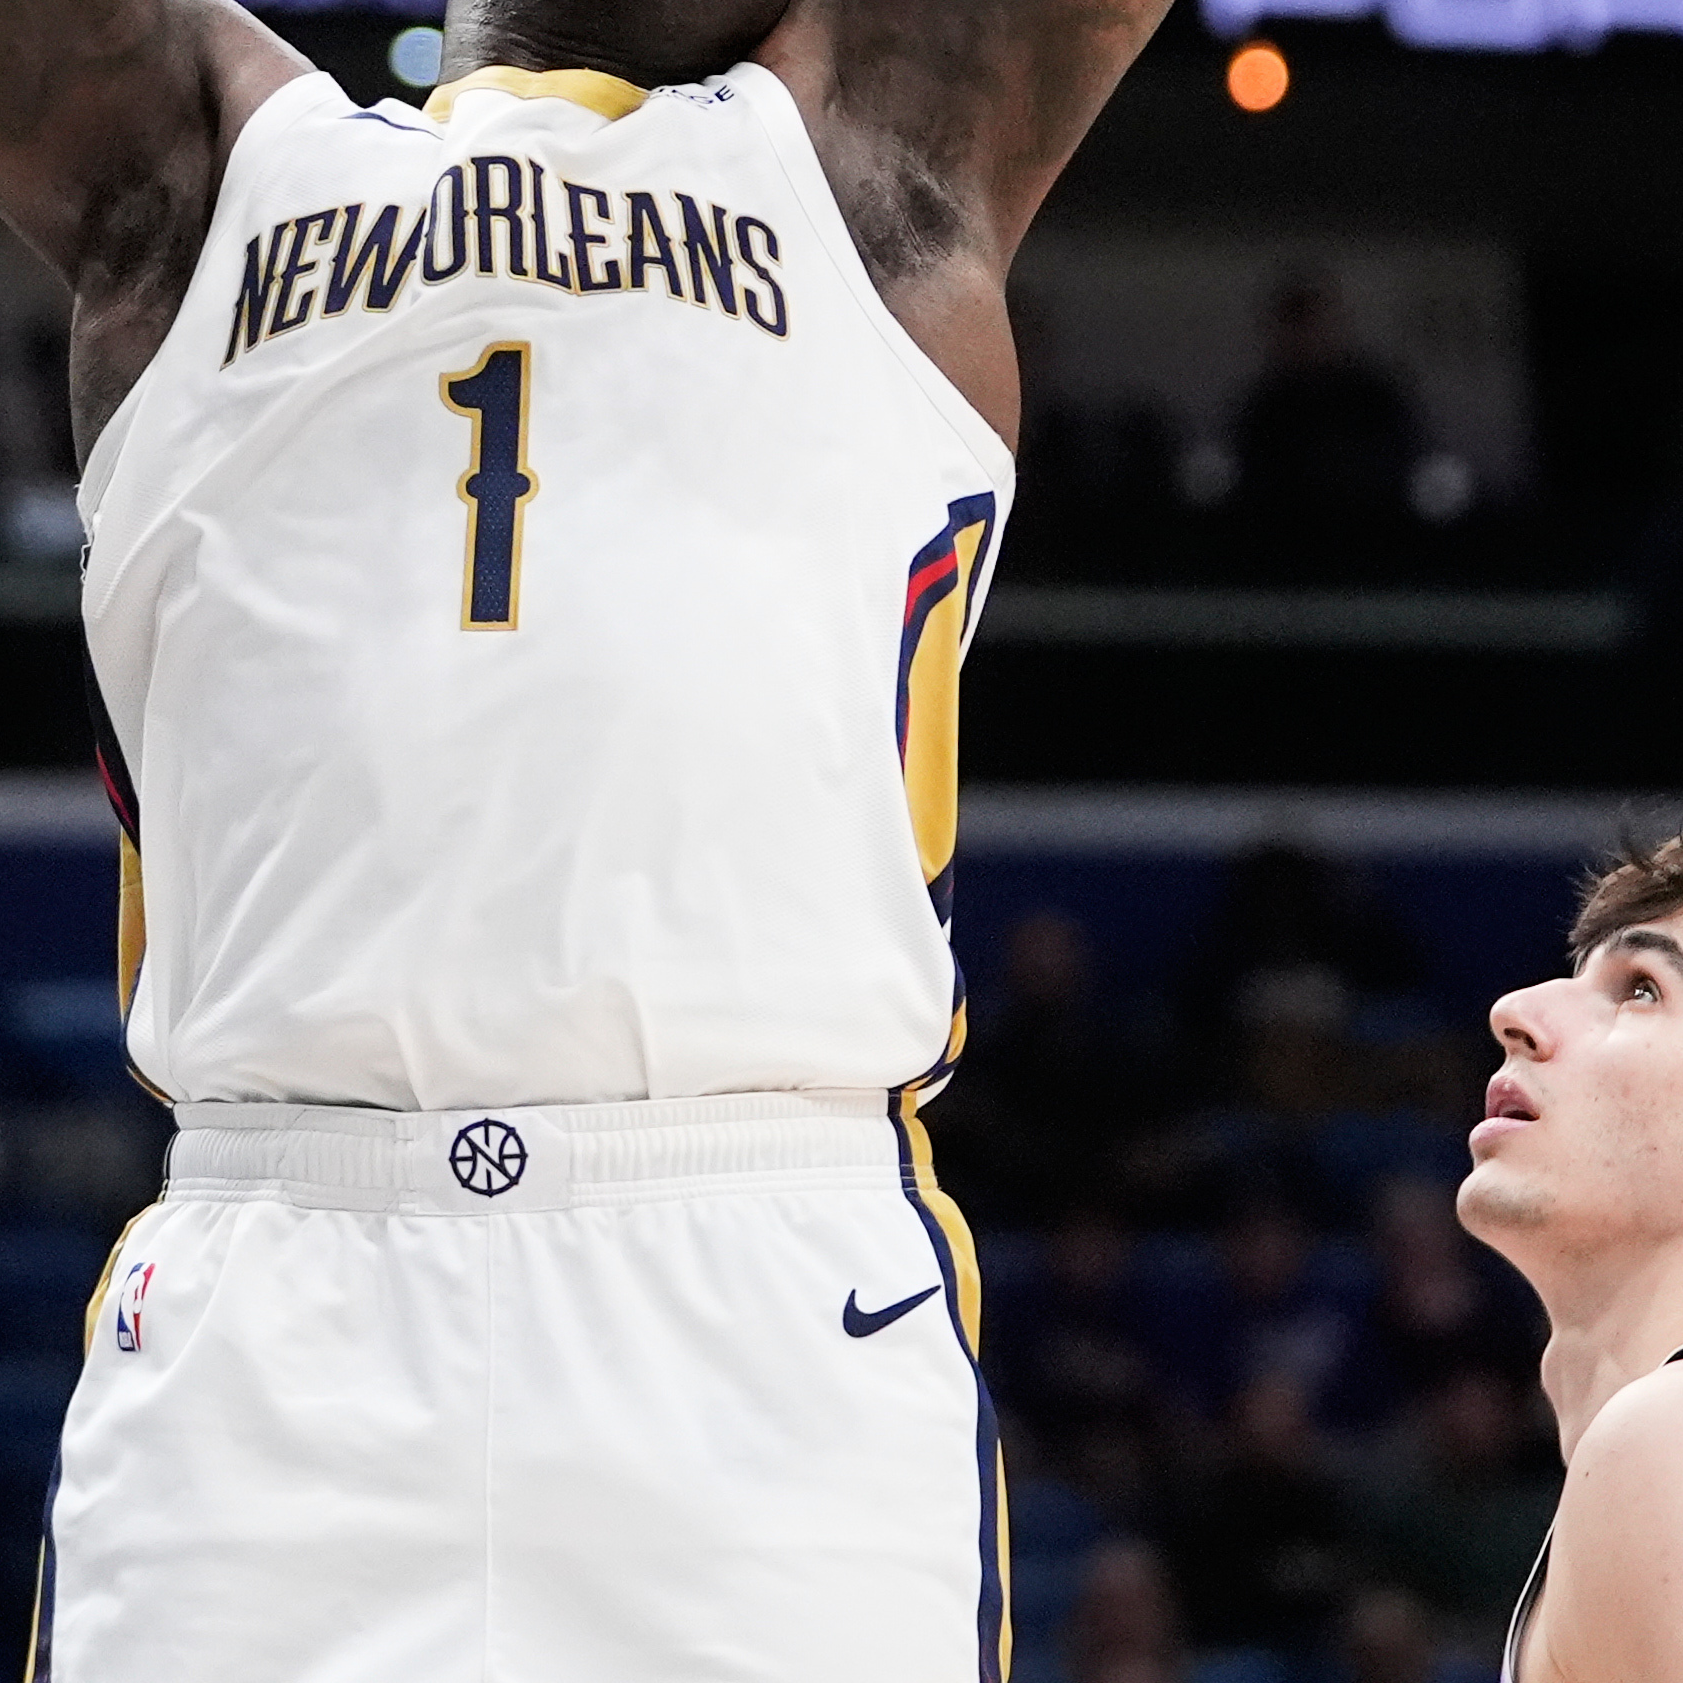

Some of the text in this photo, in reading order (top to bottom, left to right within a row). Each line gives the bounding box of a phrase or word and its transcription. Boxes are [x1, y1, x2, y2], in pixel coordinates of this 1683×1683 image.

[219, 154, 790, 372] NEW ORLEANS
[438, 340, 540, 632] 1
